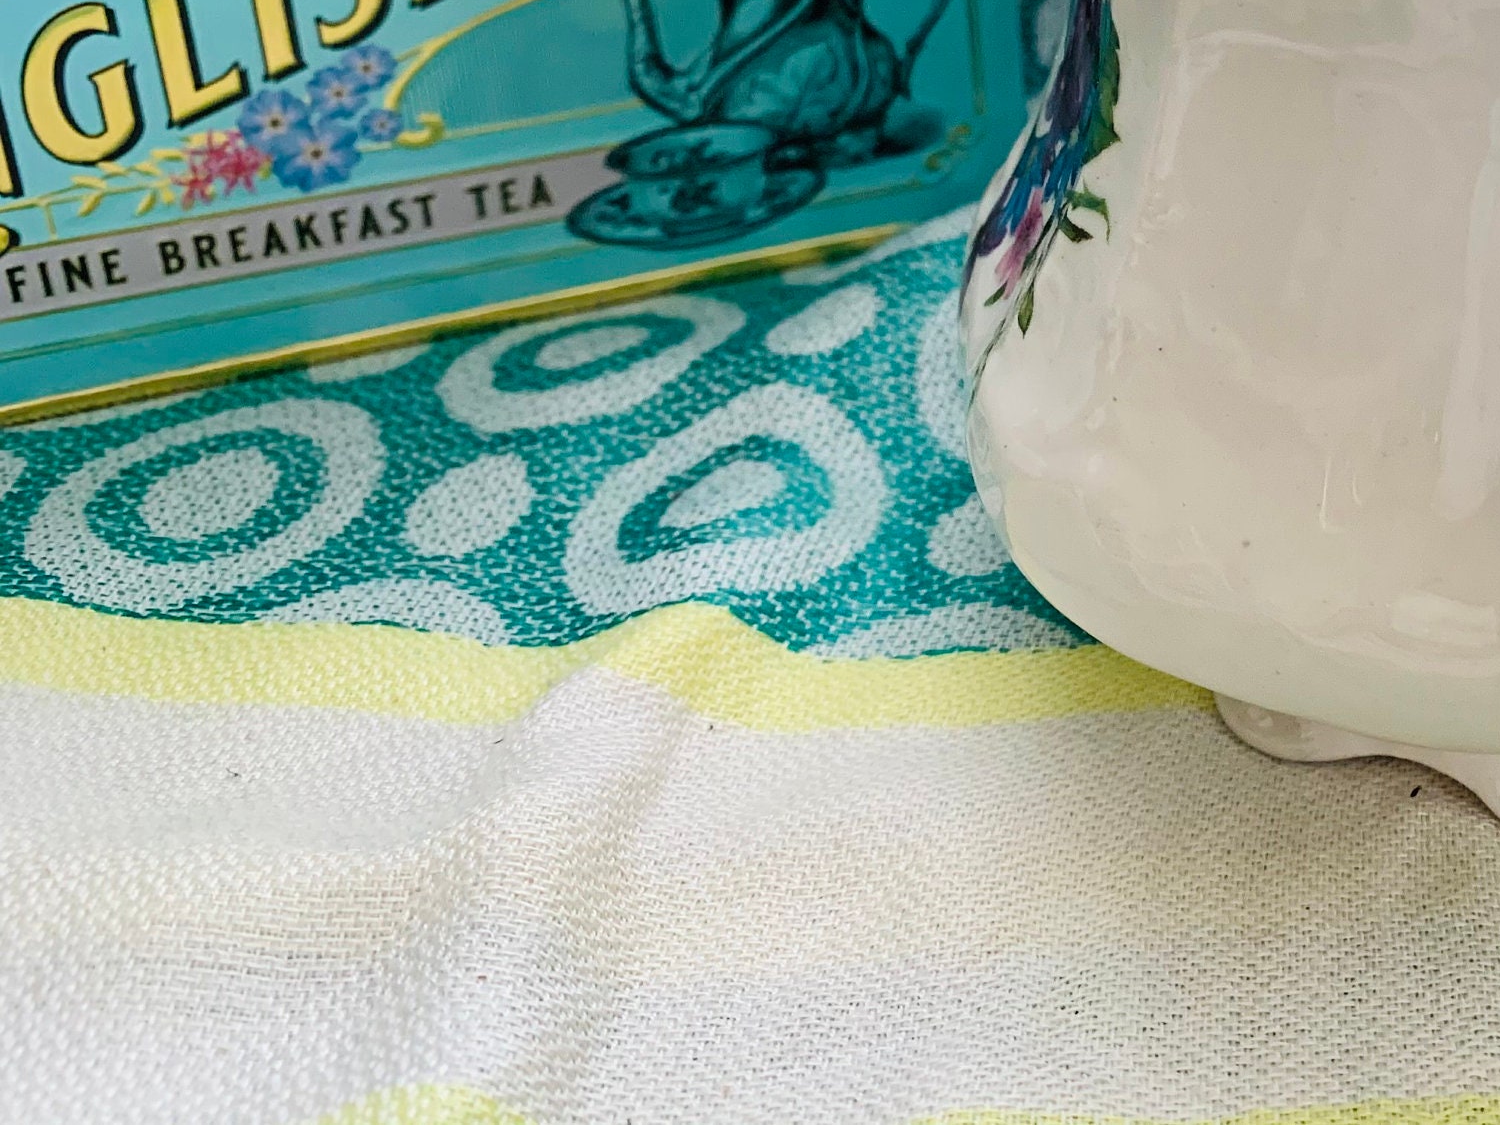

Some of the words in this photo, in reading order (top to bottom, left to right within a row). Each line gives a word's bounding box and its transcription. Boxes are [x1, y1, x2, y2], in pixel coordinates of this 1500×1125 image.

[5, 248, 128, 303] FINE
[158, 193, 438, 277] BREAKFAST
[467, 174, 555, 221] TEA
